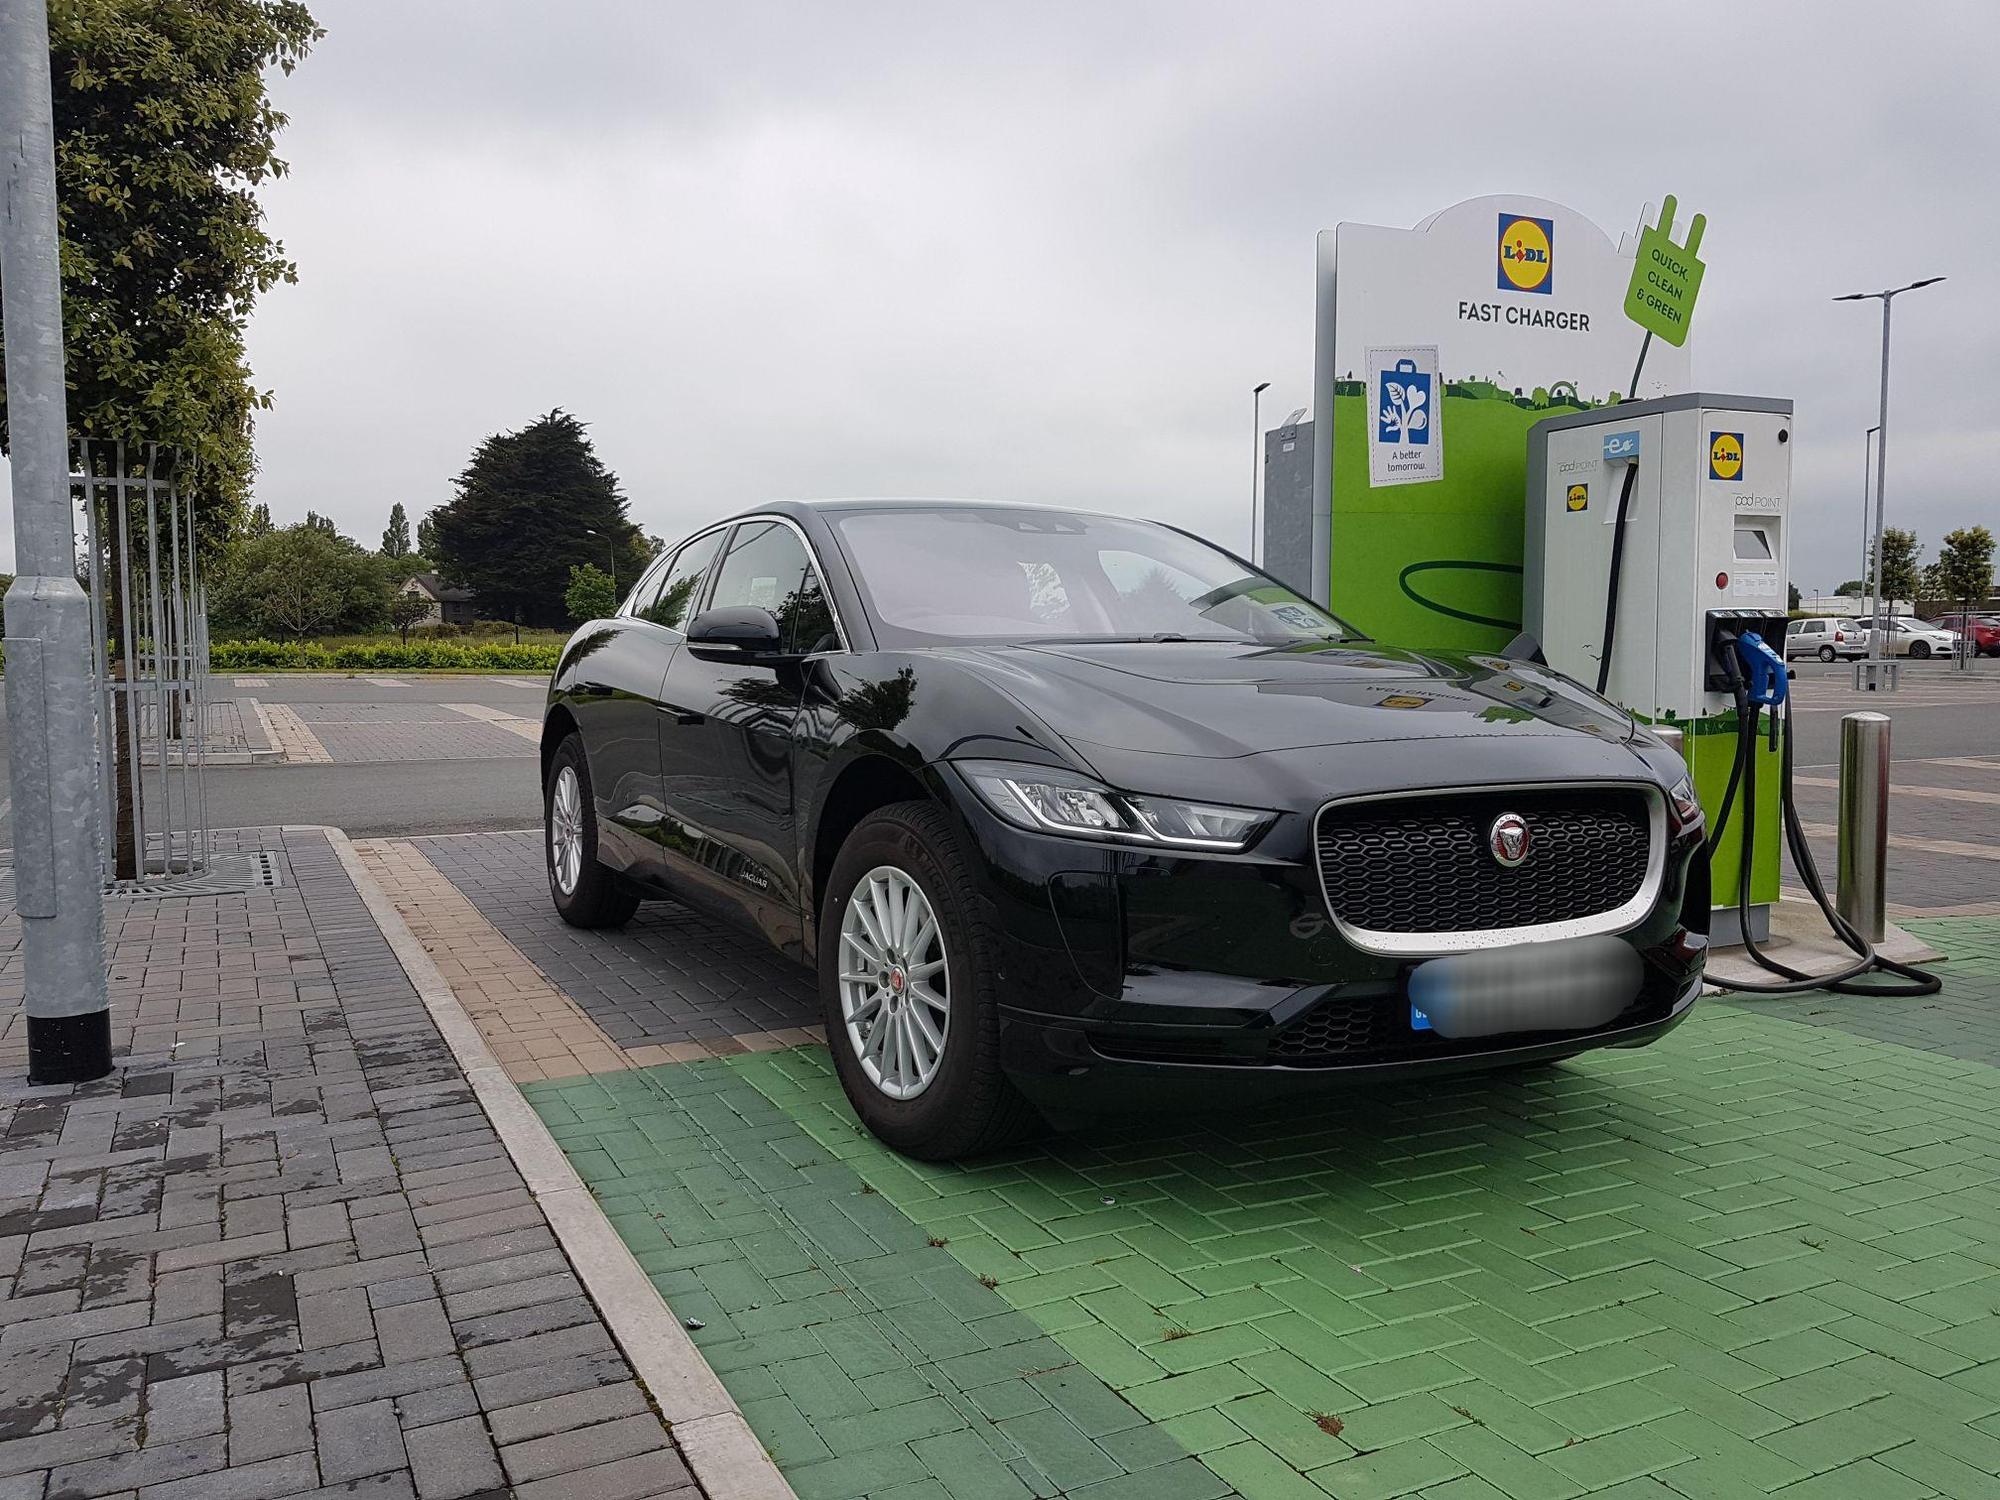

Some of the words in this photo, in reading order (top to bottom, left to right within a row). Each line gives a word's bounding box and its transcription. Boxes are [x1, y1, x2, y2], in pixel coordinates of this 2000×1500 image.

[1647, 270, 1683, 301] CLEAN
[1458, 300, 1502, 323] FAST
[1505, 305, 1590, 332] CHARGER
[1636, 287, 1645, 300] &
[1646, 294, 1682, 325] GREEN
[1392, 451, 1399, 460] A
[1399, 449, 1422, 460] better
[740, 871, 768, 888] JAGUAR
